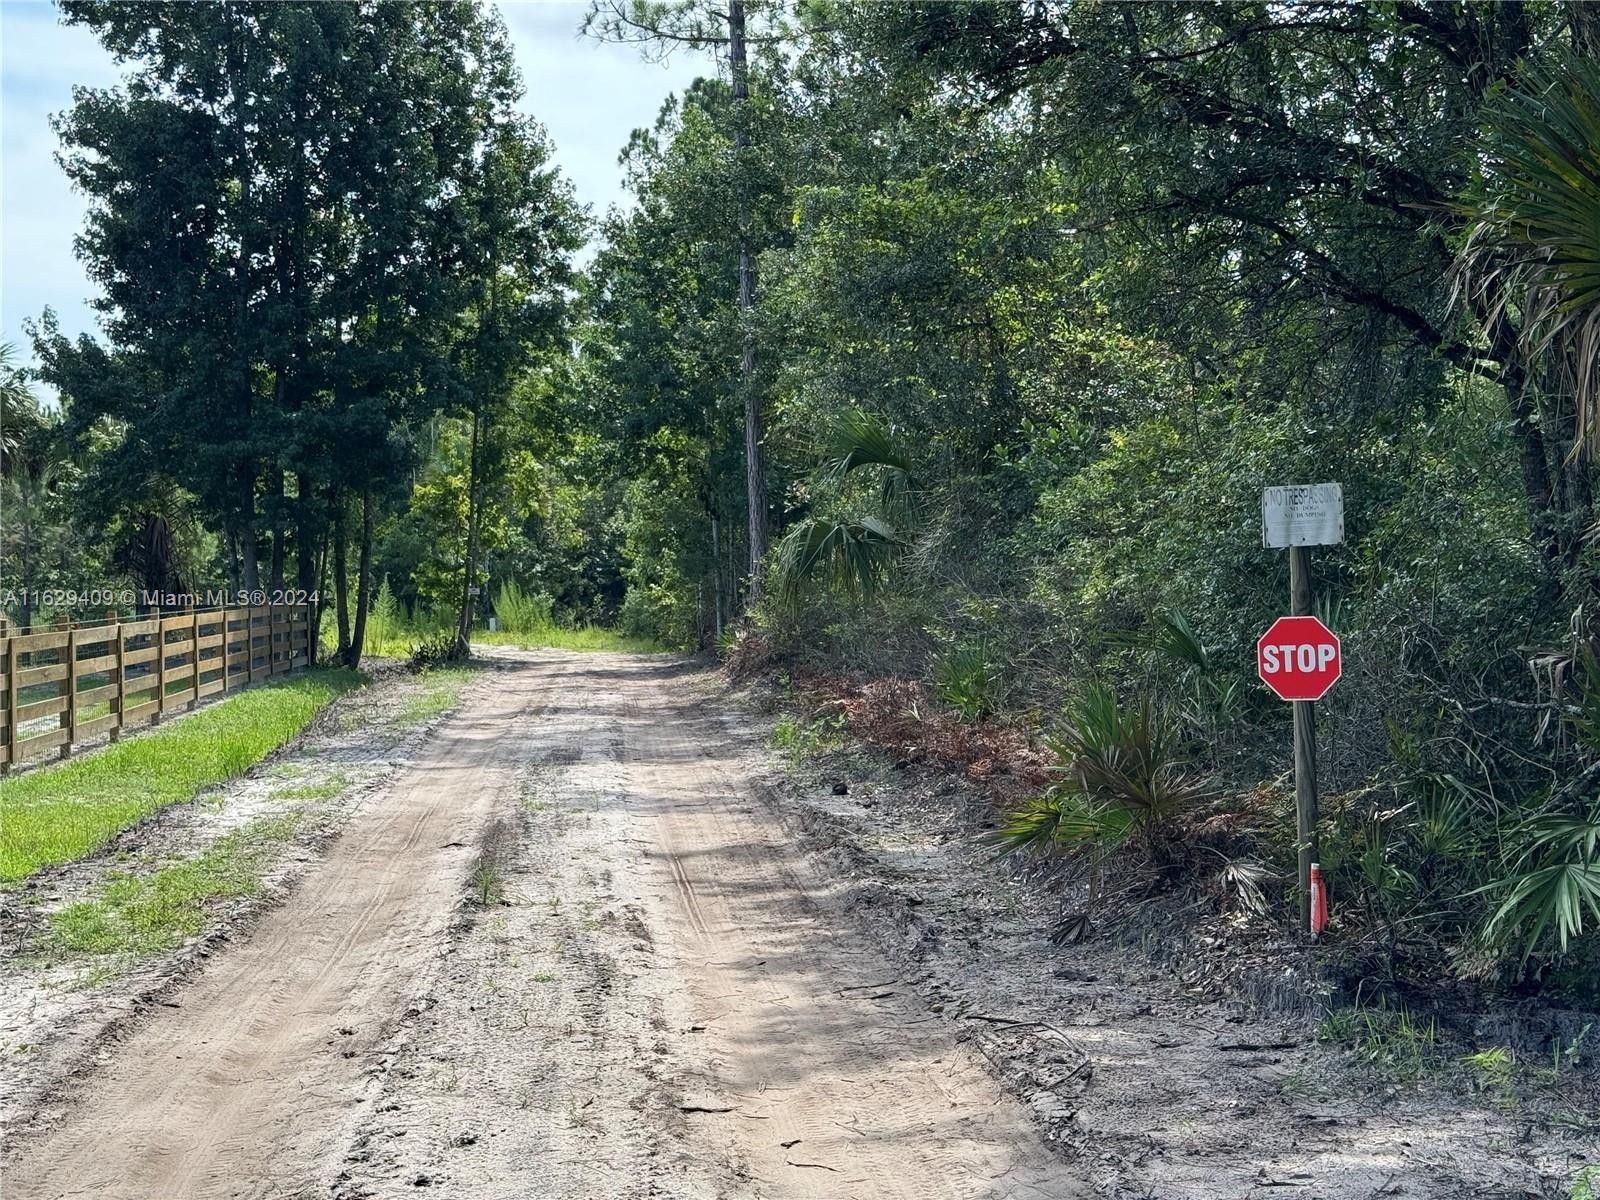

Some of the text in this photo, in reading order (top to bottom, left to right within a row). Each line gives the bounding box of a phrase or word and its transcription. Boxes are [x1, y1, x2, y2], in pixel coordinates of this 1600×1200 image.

[1269, 486, 1338, 506] NO TRESPASSING
[1263, 644, 1336, 674] STOP
